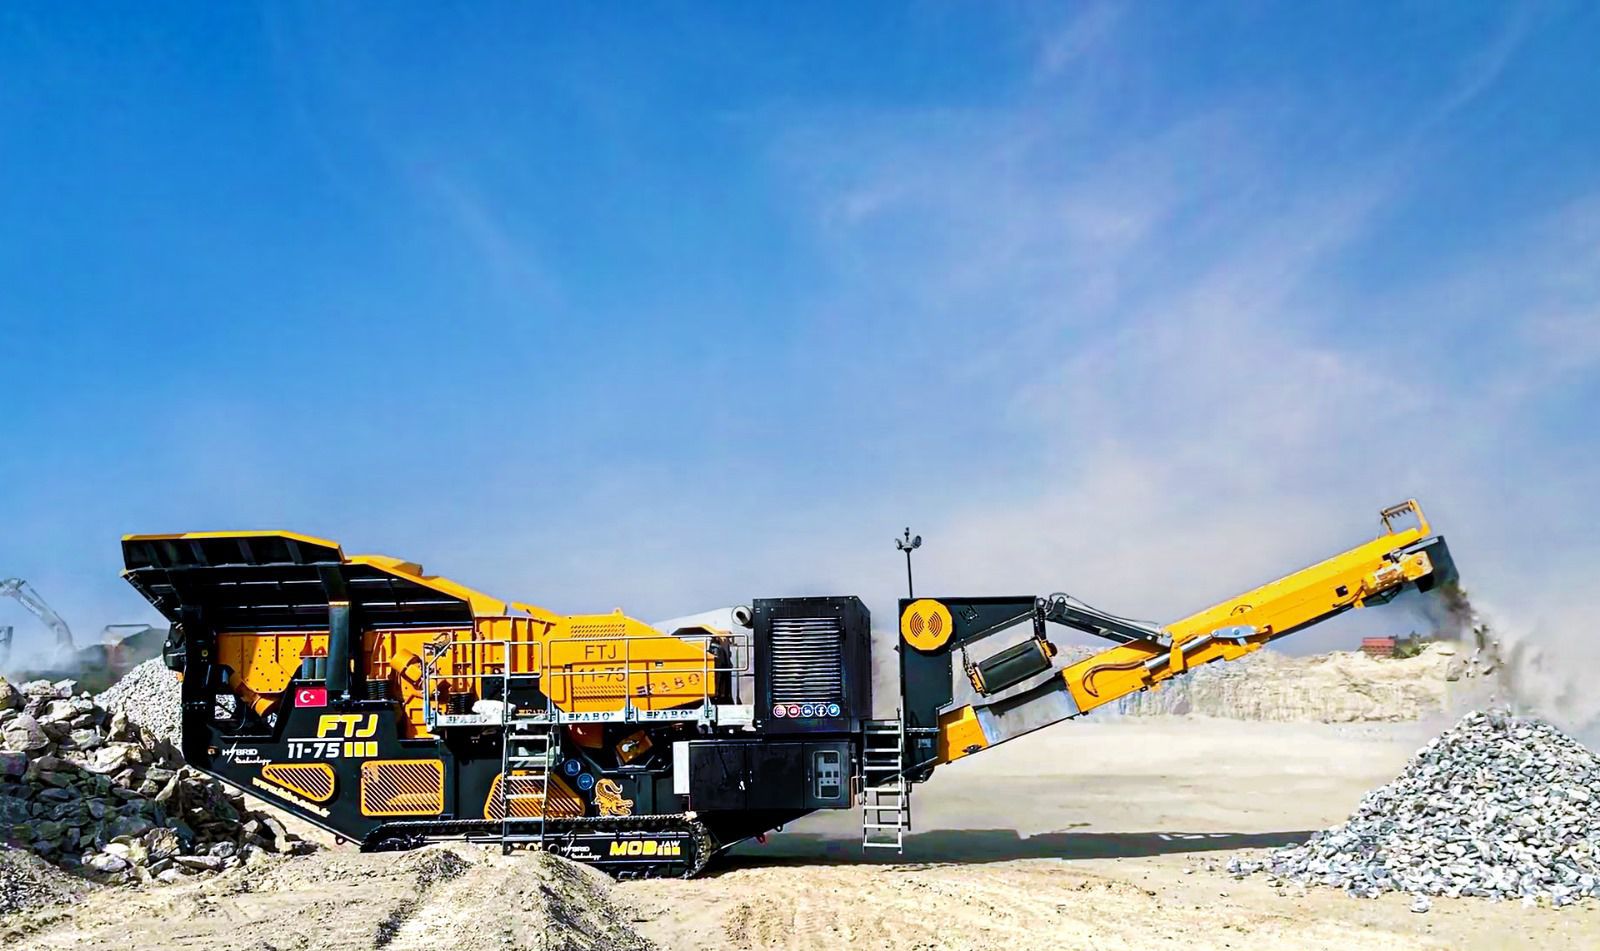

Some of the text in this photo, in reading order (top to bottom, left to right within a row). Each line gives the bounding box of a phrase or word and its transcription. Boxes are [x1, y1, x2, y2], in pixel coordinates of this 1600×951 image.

[585, 644, 617, 660] FTJ
[317, 714, 379, 738] FTJ
[287, 742, 341, 759] 11-75
